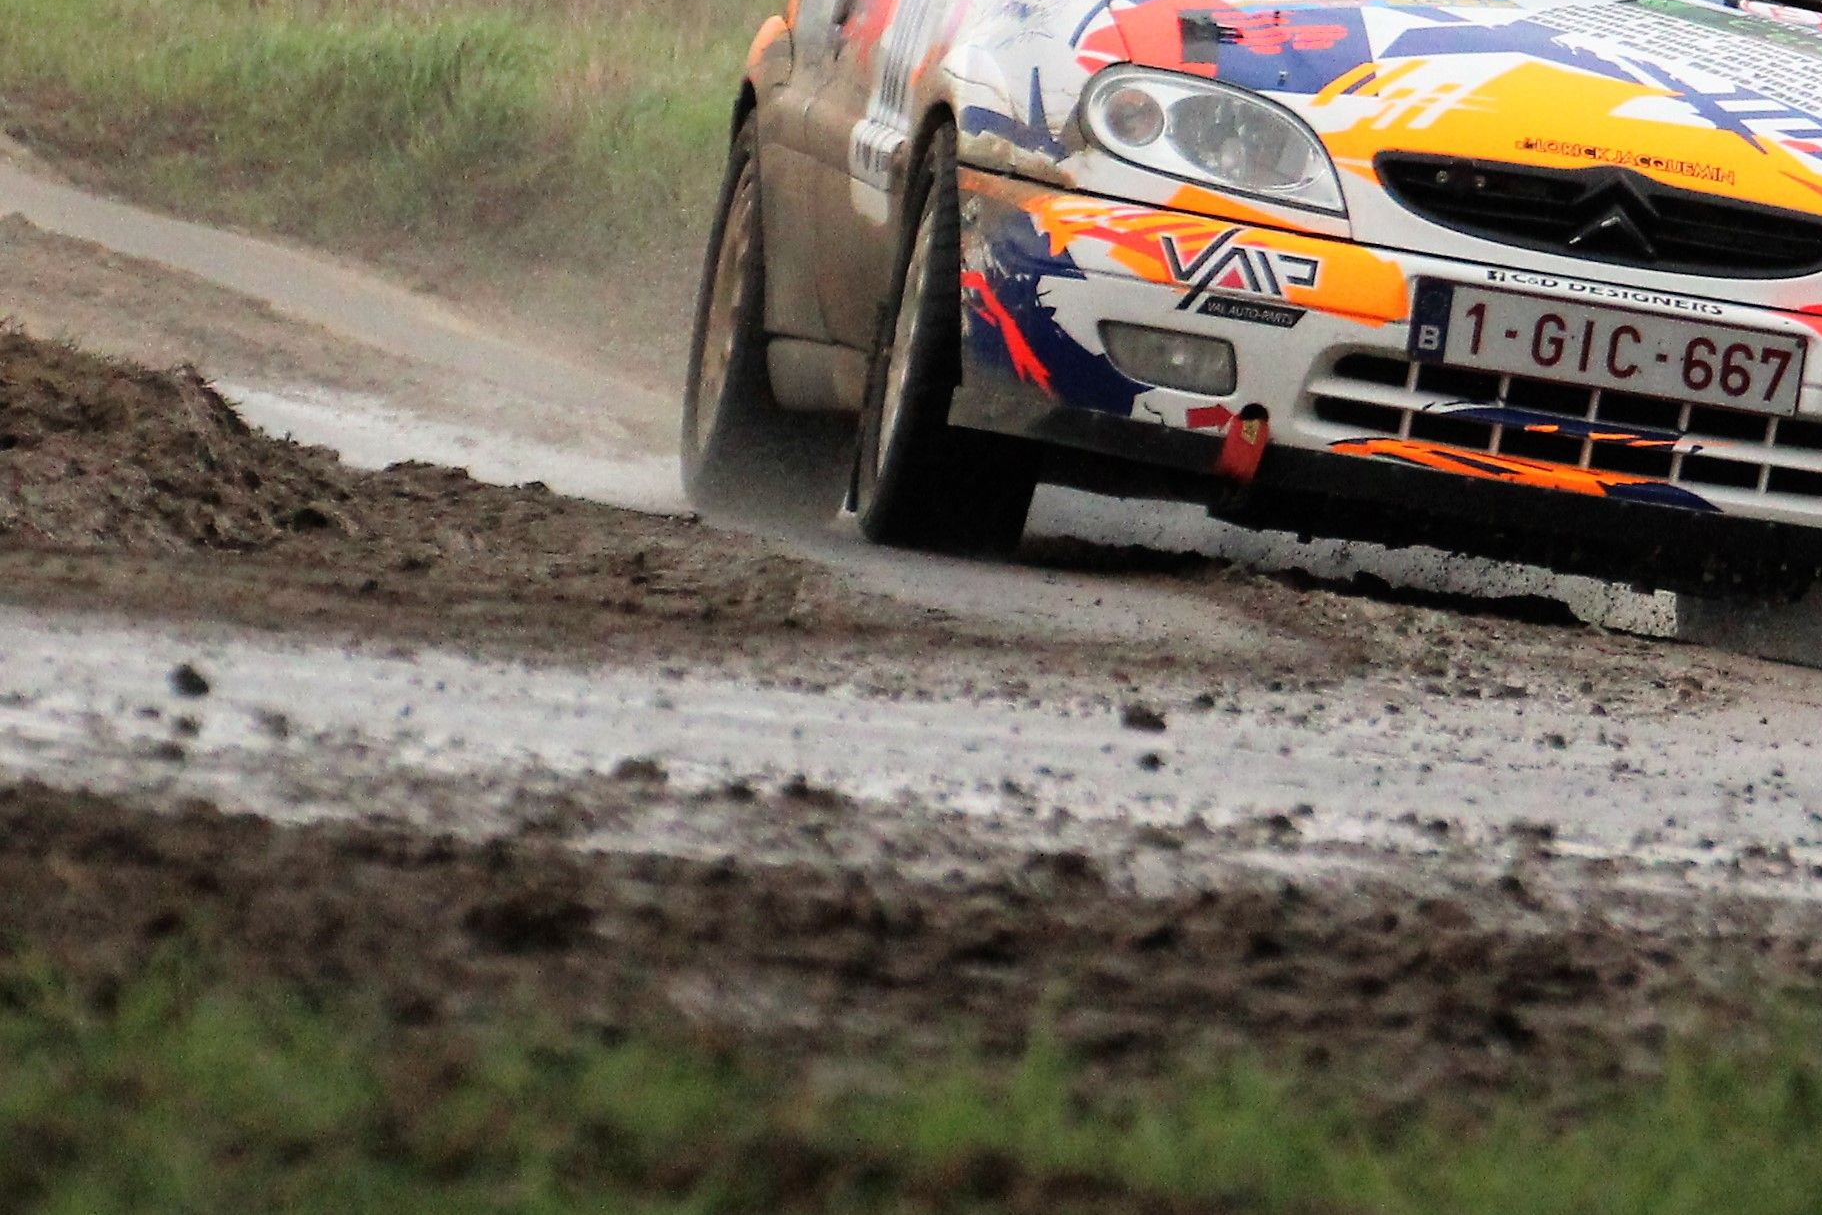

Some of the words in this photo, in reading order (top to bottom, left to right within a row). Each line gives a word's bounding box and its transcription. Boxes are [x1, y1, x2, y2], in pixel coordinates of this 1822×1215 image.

[1567, 283, 1724, 316] DESIGNERS
[1417, 325, 1440, 351] B
[1465, 302, 1793, 403] 1-GIC-667
